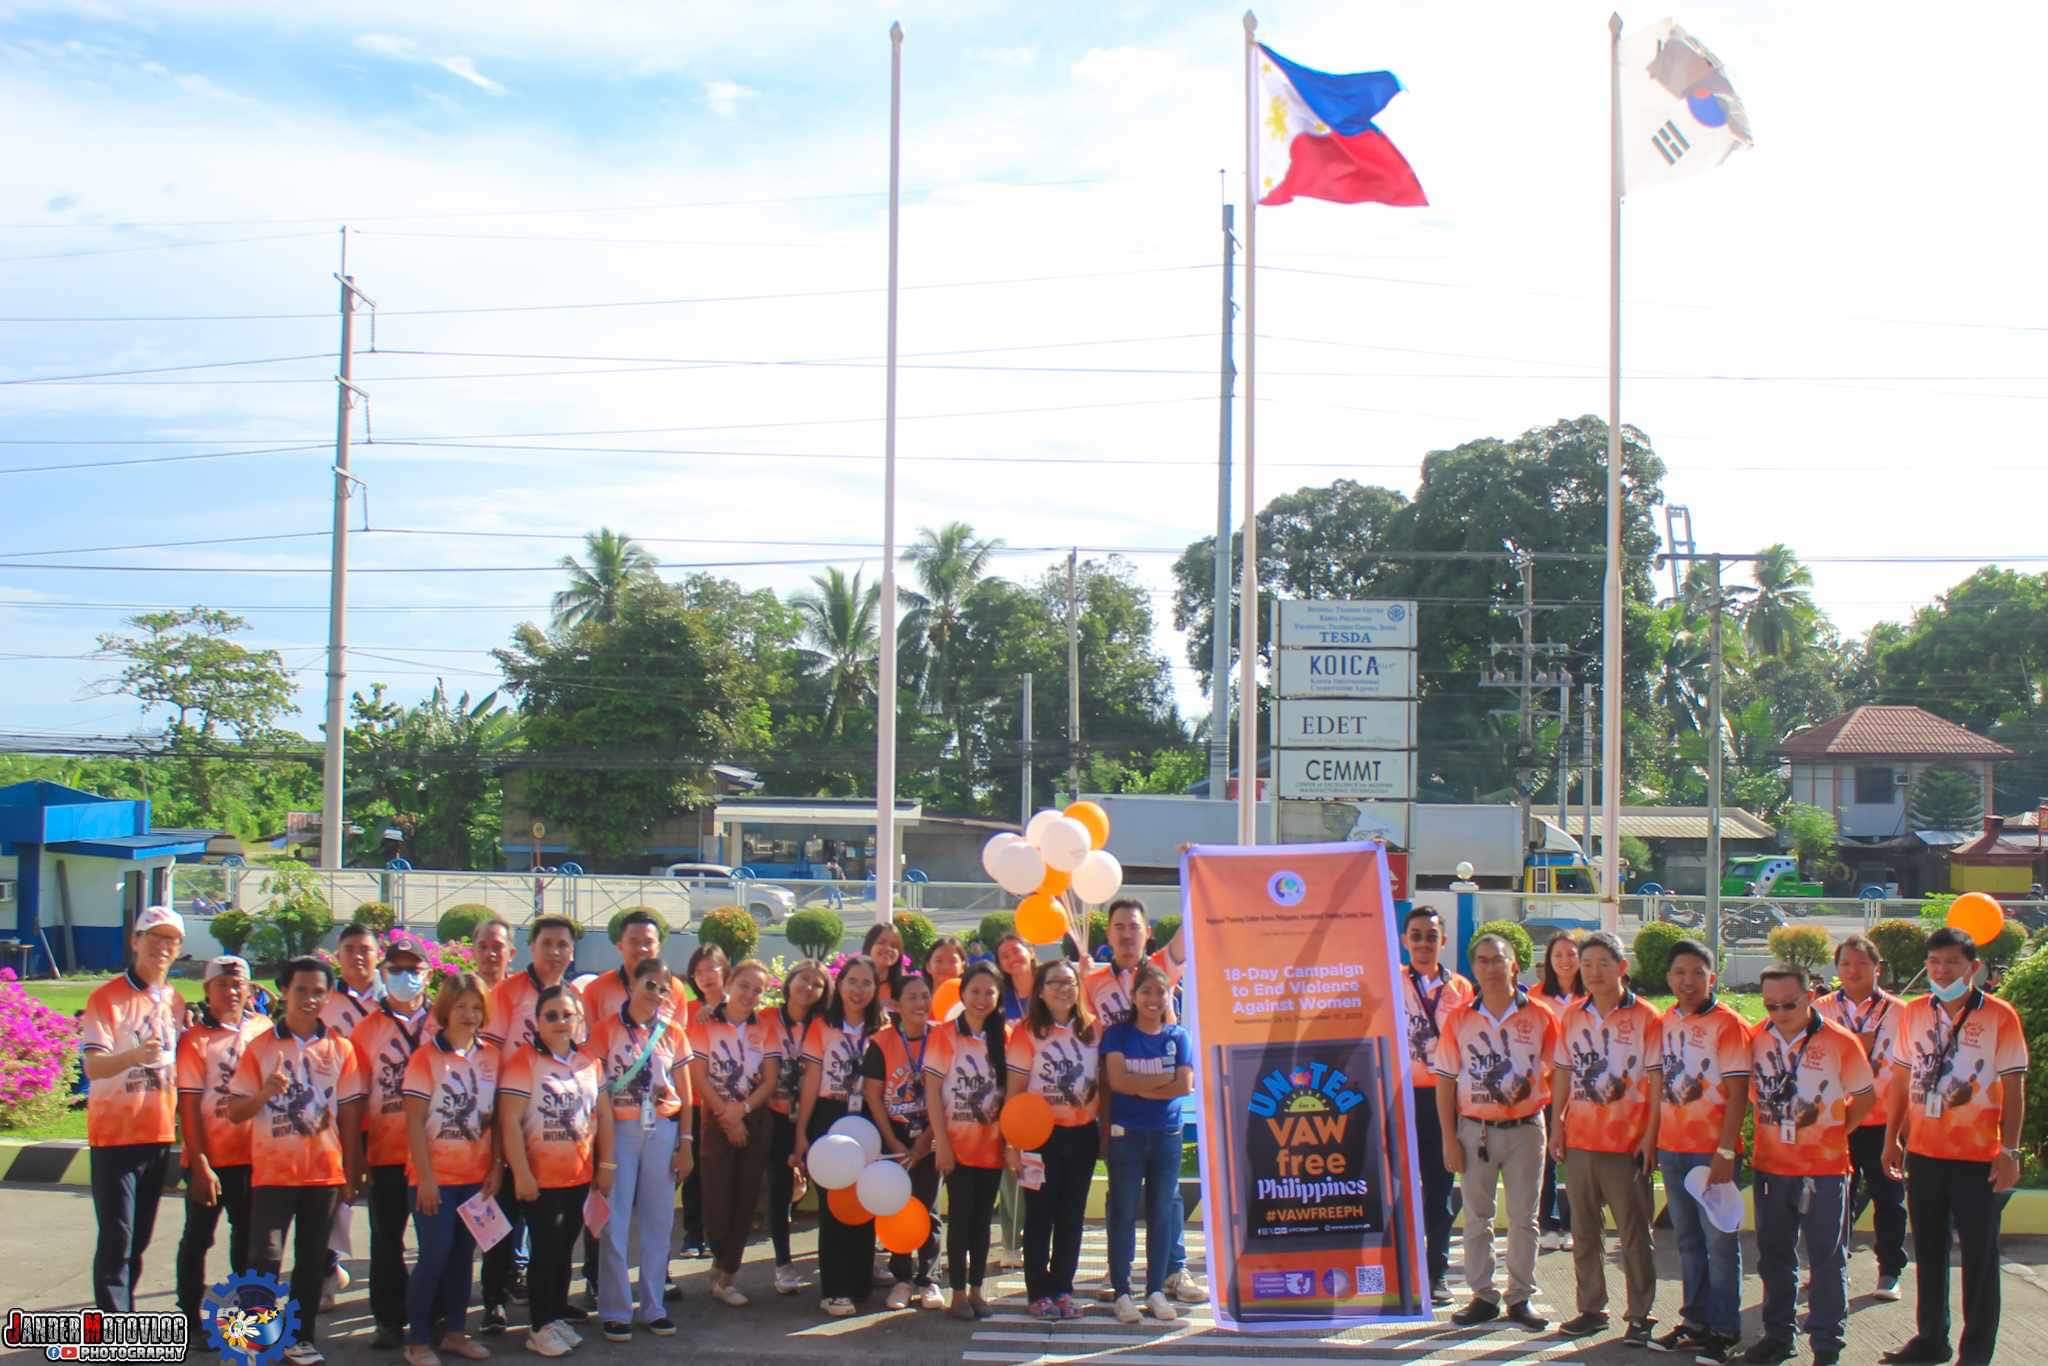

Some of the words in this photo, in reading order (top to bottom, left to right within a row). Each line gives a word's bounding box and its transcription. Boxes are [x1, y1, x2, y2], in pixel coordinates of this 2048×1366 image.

[1319, 632, 1372, 644] TESDA
[1310, 655, 1379, 676] KOICA
[1302, 716, 1367, 735] EDET
[1306, 759, 1381, 781] CEMMT
[1284, 963, 1364, 979] Campaign
[1231, 985, 1249, 997] to
[1253, 983, 1285, 996] End
[1290, 980, 1360, 994] Violence
[1232, 998, 1295, 1015] Against
[1300, 996, 1361, 1010] Women
[1266, 1115, 1349, 1147] VAW
[1275, 1149, 1347, 1177] free
[1257, 1176, 1368, 1204] Philippines
[1264, 1205, 1364, 1223] #VAWFREEPH
